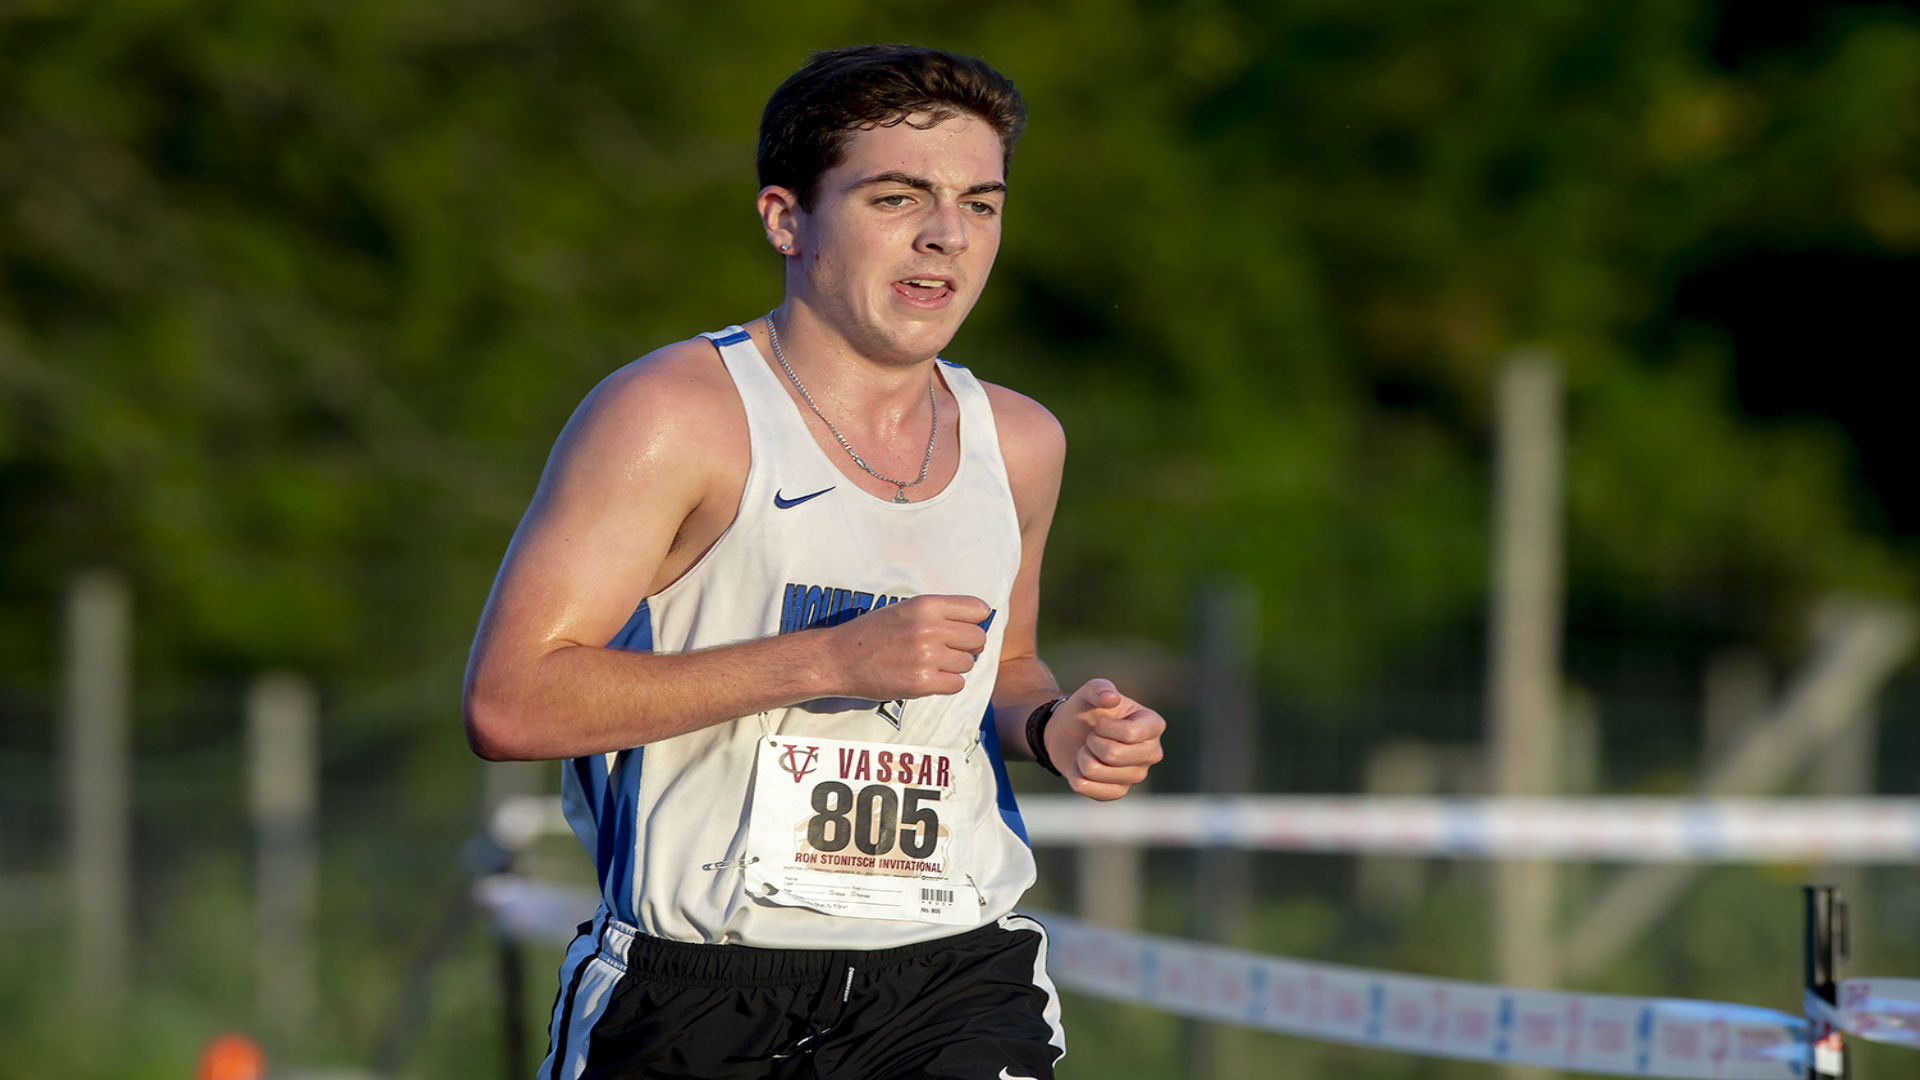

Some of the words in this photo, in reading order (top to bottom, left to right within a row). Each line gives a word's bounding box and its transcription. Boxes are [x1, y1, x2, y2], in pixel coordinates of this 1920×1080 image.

[838, 747, 950, 787] VASSAR
[807, 780, 941, 859] 805
[795, 852, 817, 863] RON
[820, 854, 875, 868] STONITSCH
[879, 859, 942, 873] INVITATIONAL
